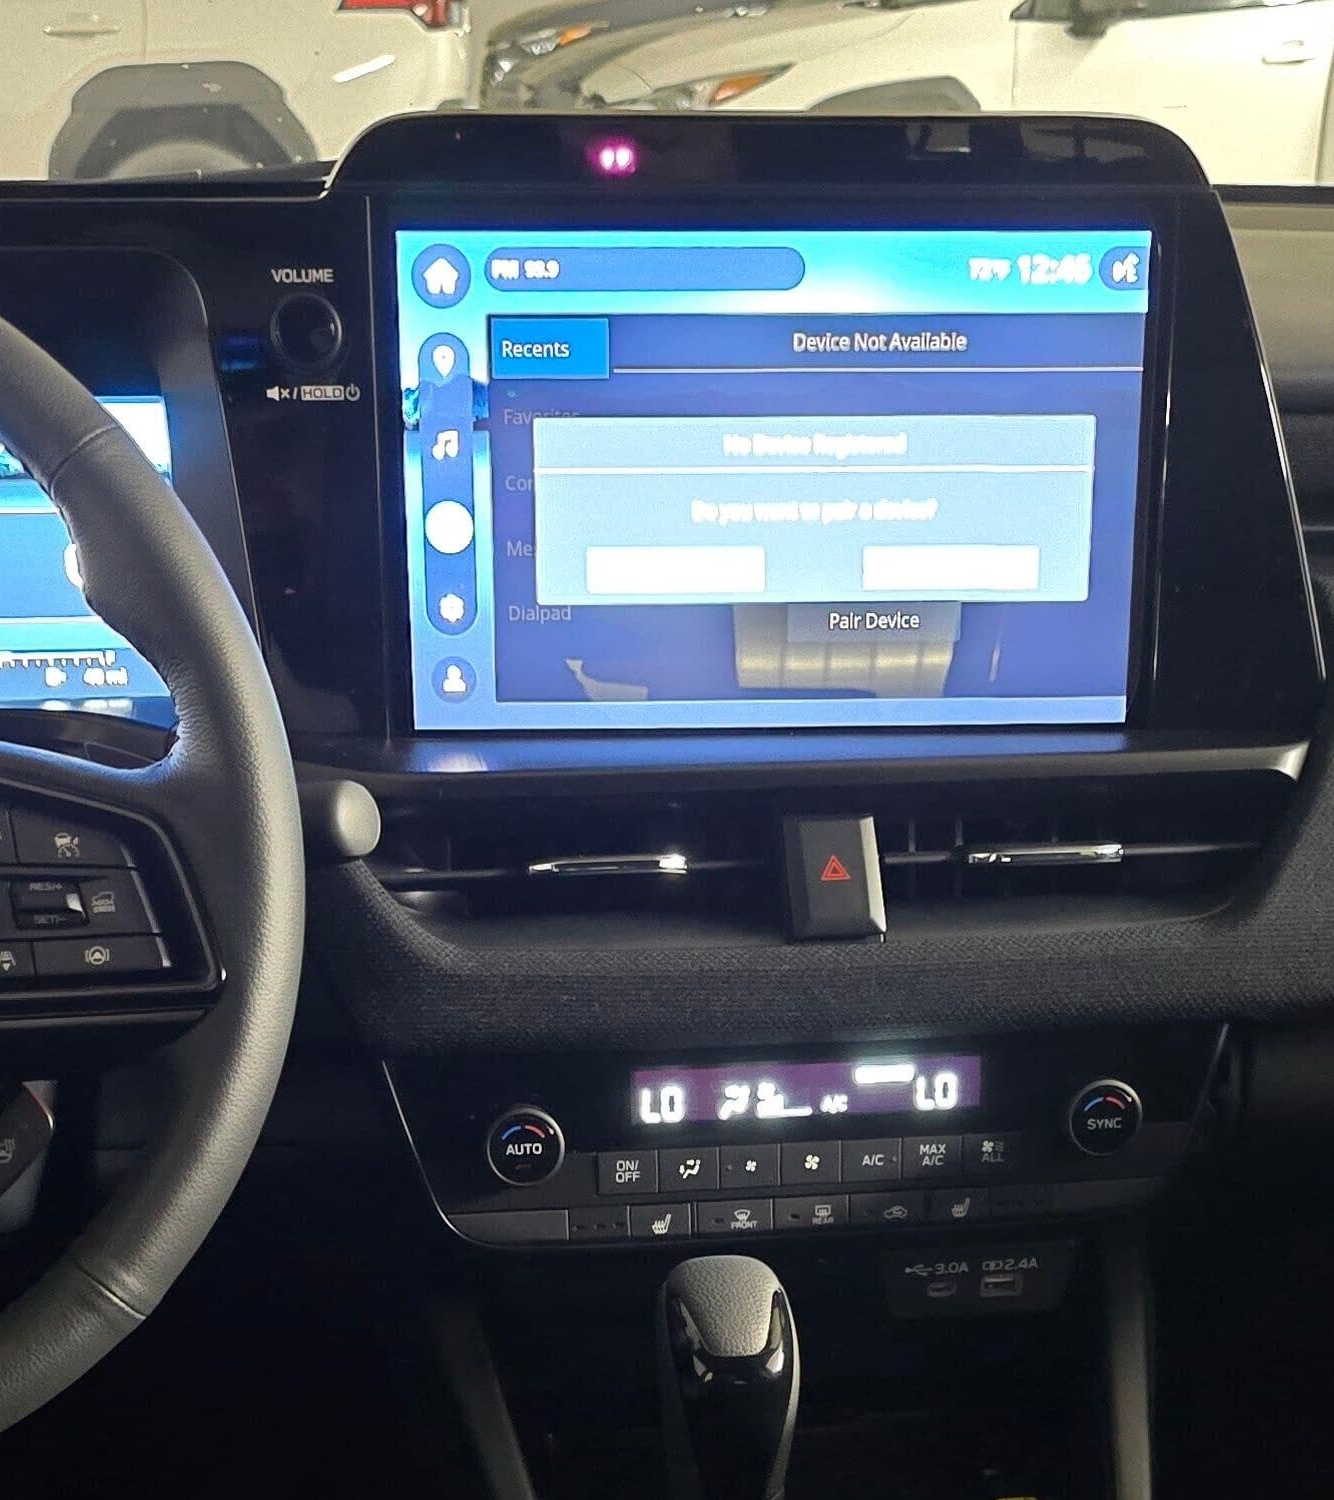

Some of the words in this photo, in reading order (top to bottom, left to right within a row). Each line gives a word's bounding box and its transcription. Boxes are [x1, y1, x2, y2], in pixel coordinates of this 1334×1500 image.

[270, 268, 335, 284] VOLUME
[502, 339, 571, 358] Recents
[793, 332, 851, 352] Device
[853, 332, 888, 352] Not
[888, 331, 968, 352] Available
[302, 387, 343, 399] HOLD
[508, 604, 572, 624] Dialpad
[828, 612, 862, 630] Pair
[864, 611, 921, 630] Device
[1087, 1116, 1123, 1131] SYNC
[505, 1141, 543, 1156] AUTO
[918, 1143, 947, 1156] MAX
[862, 1153, 885, 1167] A/C
[920, 1154, 946, 1167] A/C
[981, 1150, 1006, 1164] ALL
[615, 1159, 640, 1172] ON/
[615, 1171, 642, 1184] OFF
[729, 1219, 758, 1230] FRONT
[934, 1261, 970, 1275] 3.0A
[1003, 1256, 1040, 1271] 2.4A
